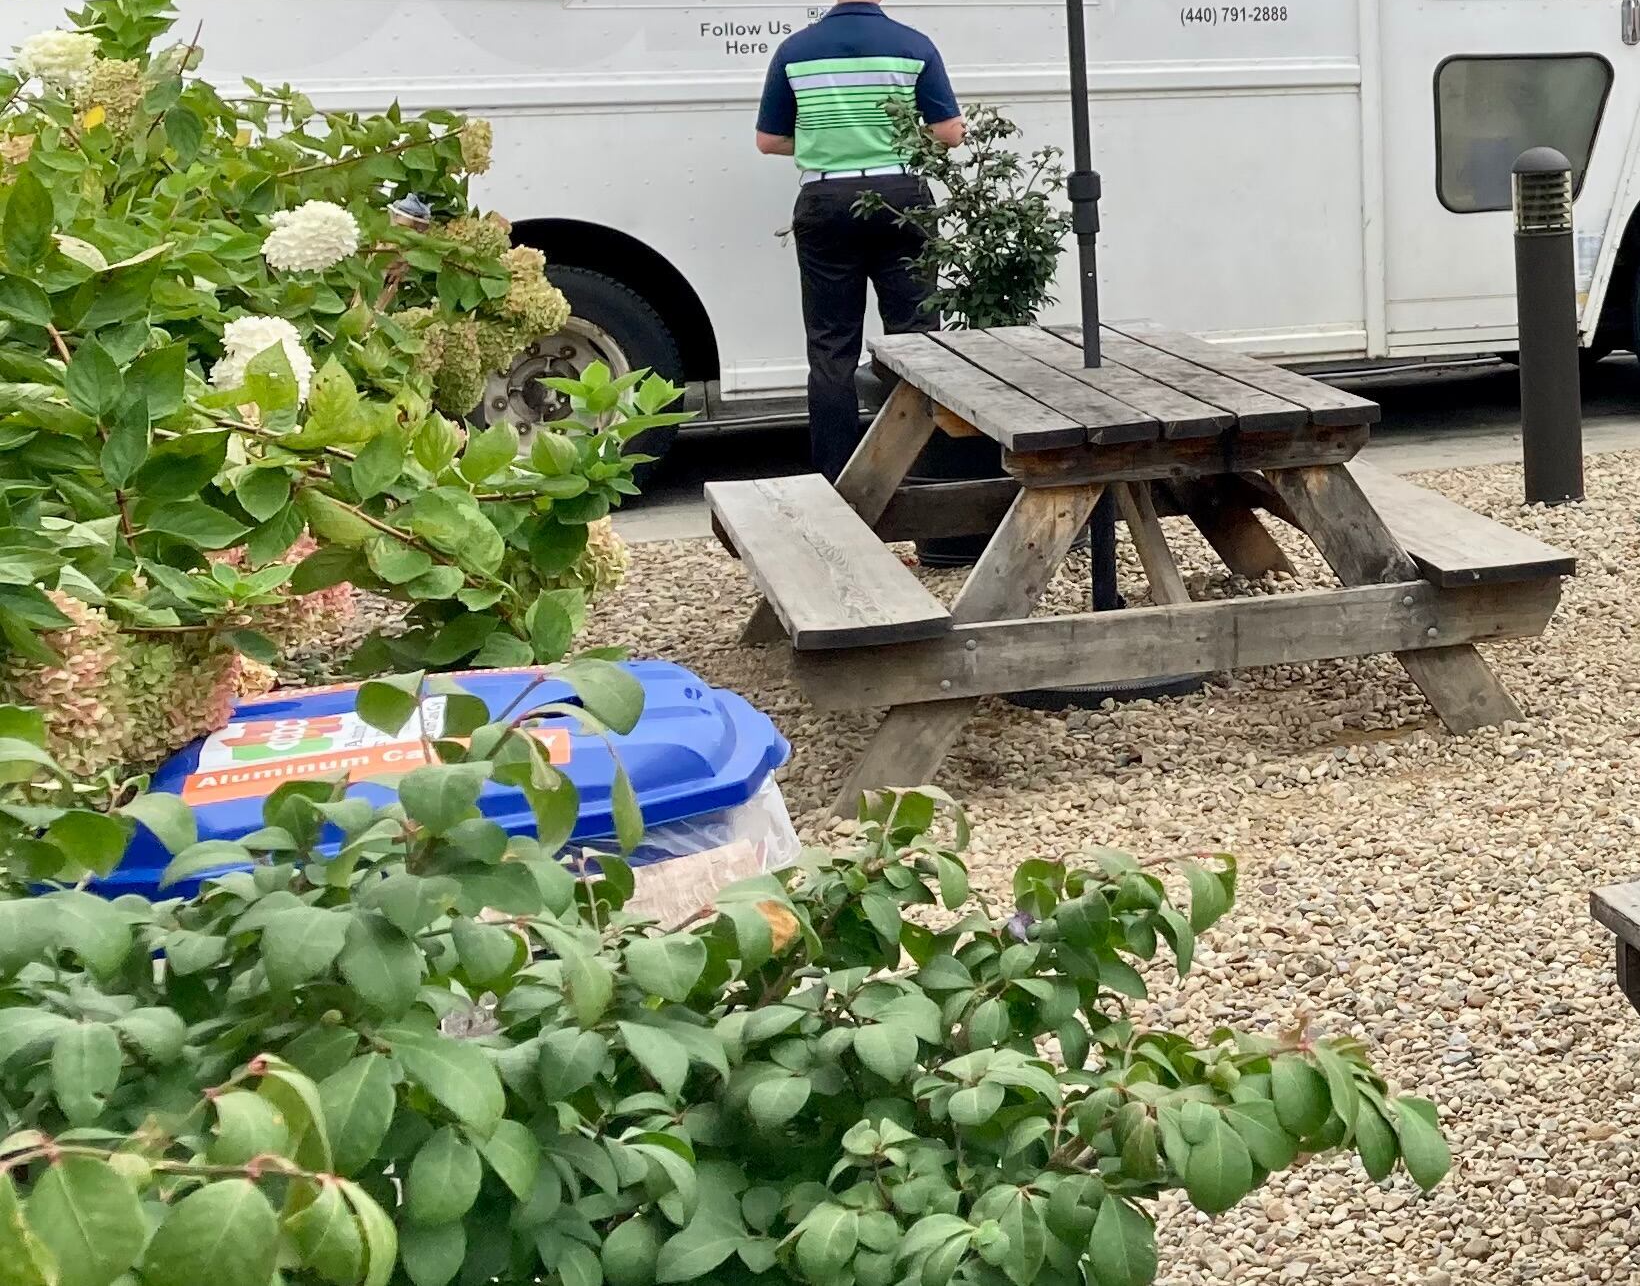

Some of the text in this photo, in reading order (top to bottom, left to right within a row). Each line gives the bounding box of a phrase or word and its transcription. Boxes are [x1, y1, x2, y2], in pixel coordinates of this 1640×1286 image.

[1180, 6, 1288, 26] (440) 791-2888
[700, 20, 792, 37] Follow Us
[725, 40, 769, 55] Here
[195, 756, 369, 789] Aluminum
